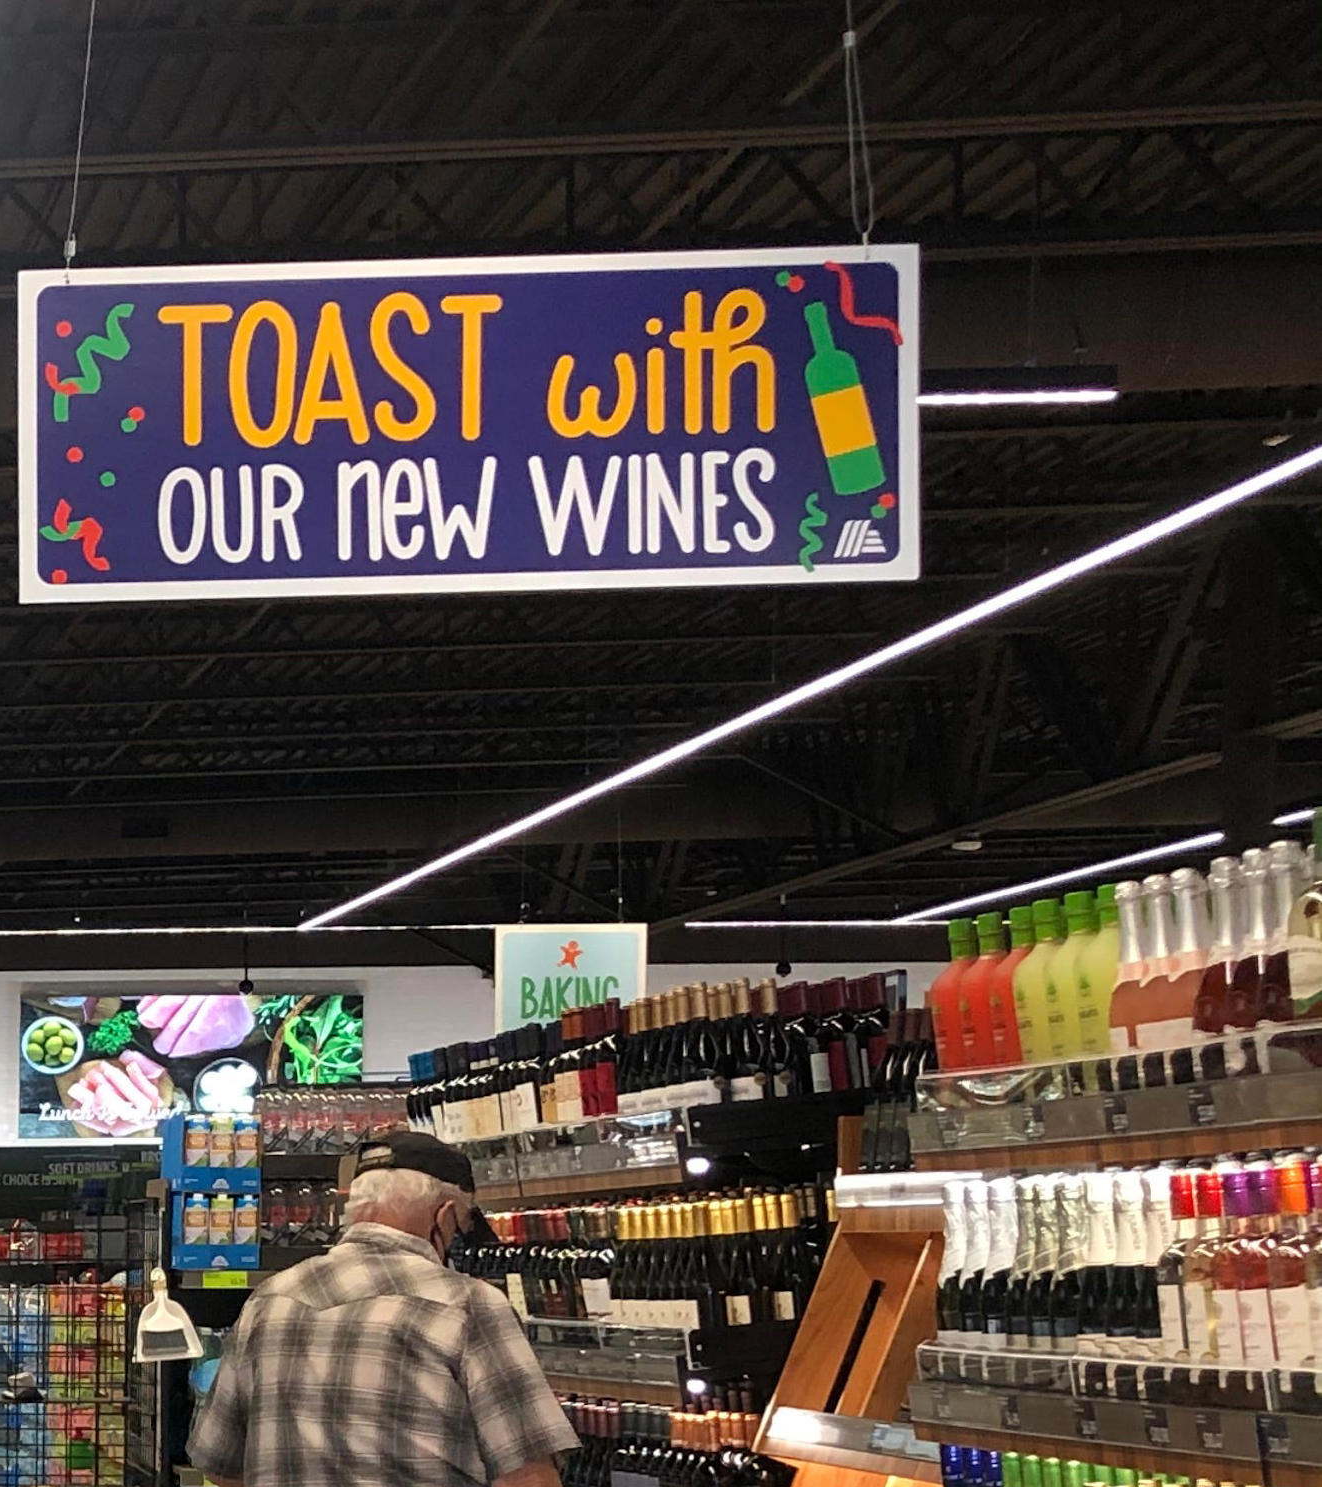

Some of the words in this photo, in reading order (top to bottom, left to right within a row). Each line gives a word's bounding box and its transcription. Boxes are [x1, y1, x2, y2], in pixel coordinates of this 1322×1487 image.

[158, 293, 503, 449] TOAST
[547, 288, 777, 438] with
[158, 463, 304, 565] OUR
[528, 448, 776, 557] WINES
[38, 1102, 93, 1121] Lunch
[48, 1163, 75, 1175] SOFT
[3, 1173, 40, 1186] CHOICE
